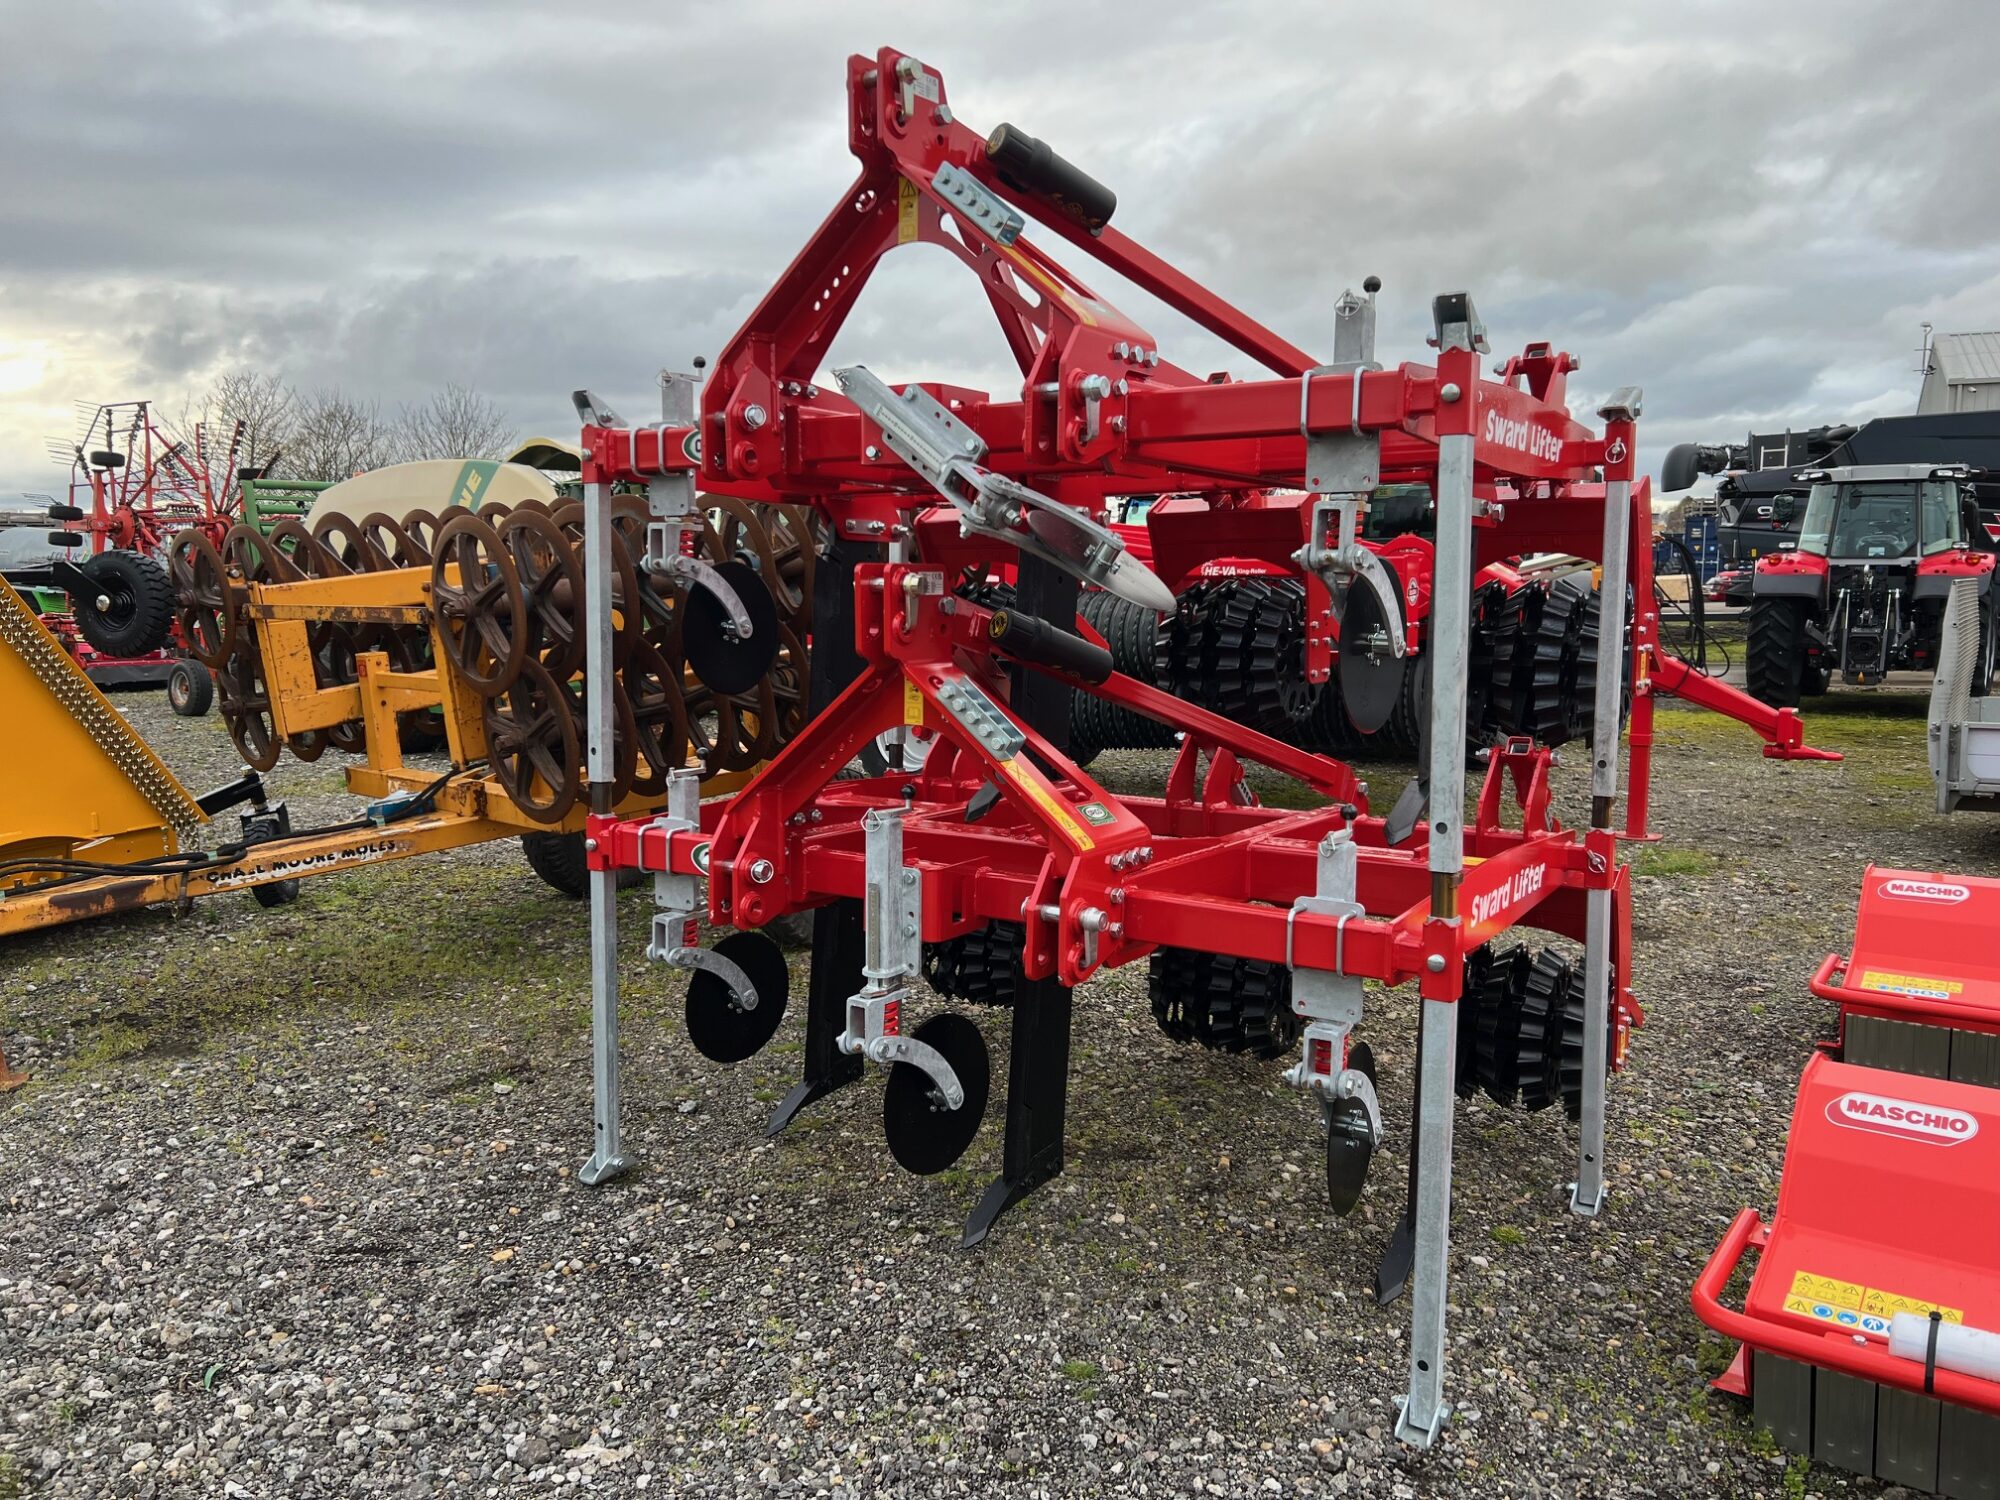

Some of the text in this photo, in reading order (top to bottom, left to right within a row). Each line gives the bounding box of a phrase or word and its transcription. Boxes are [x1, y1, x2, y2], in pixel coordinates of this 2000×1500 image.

[1486, 409, 1563, 463] Sward Lifter
[1204, 566, 1236, 576] HE-VA
[341, 839, 397, 859] MOLES
[1470, 862, 1546, 928] Sward Lifter
[1891, 883, 1965, 898] MASCHIO
[1847, 1099, 1969, 1134] MASCHIO
